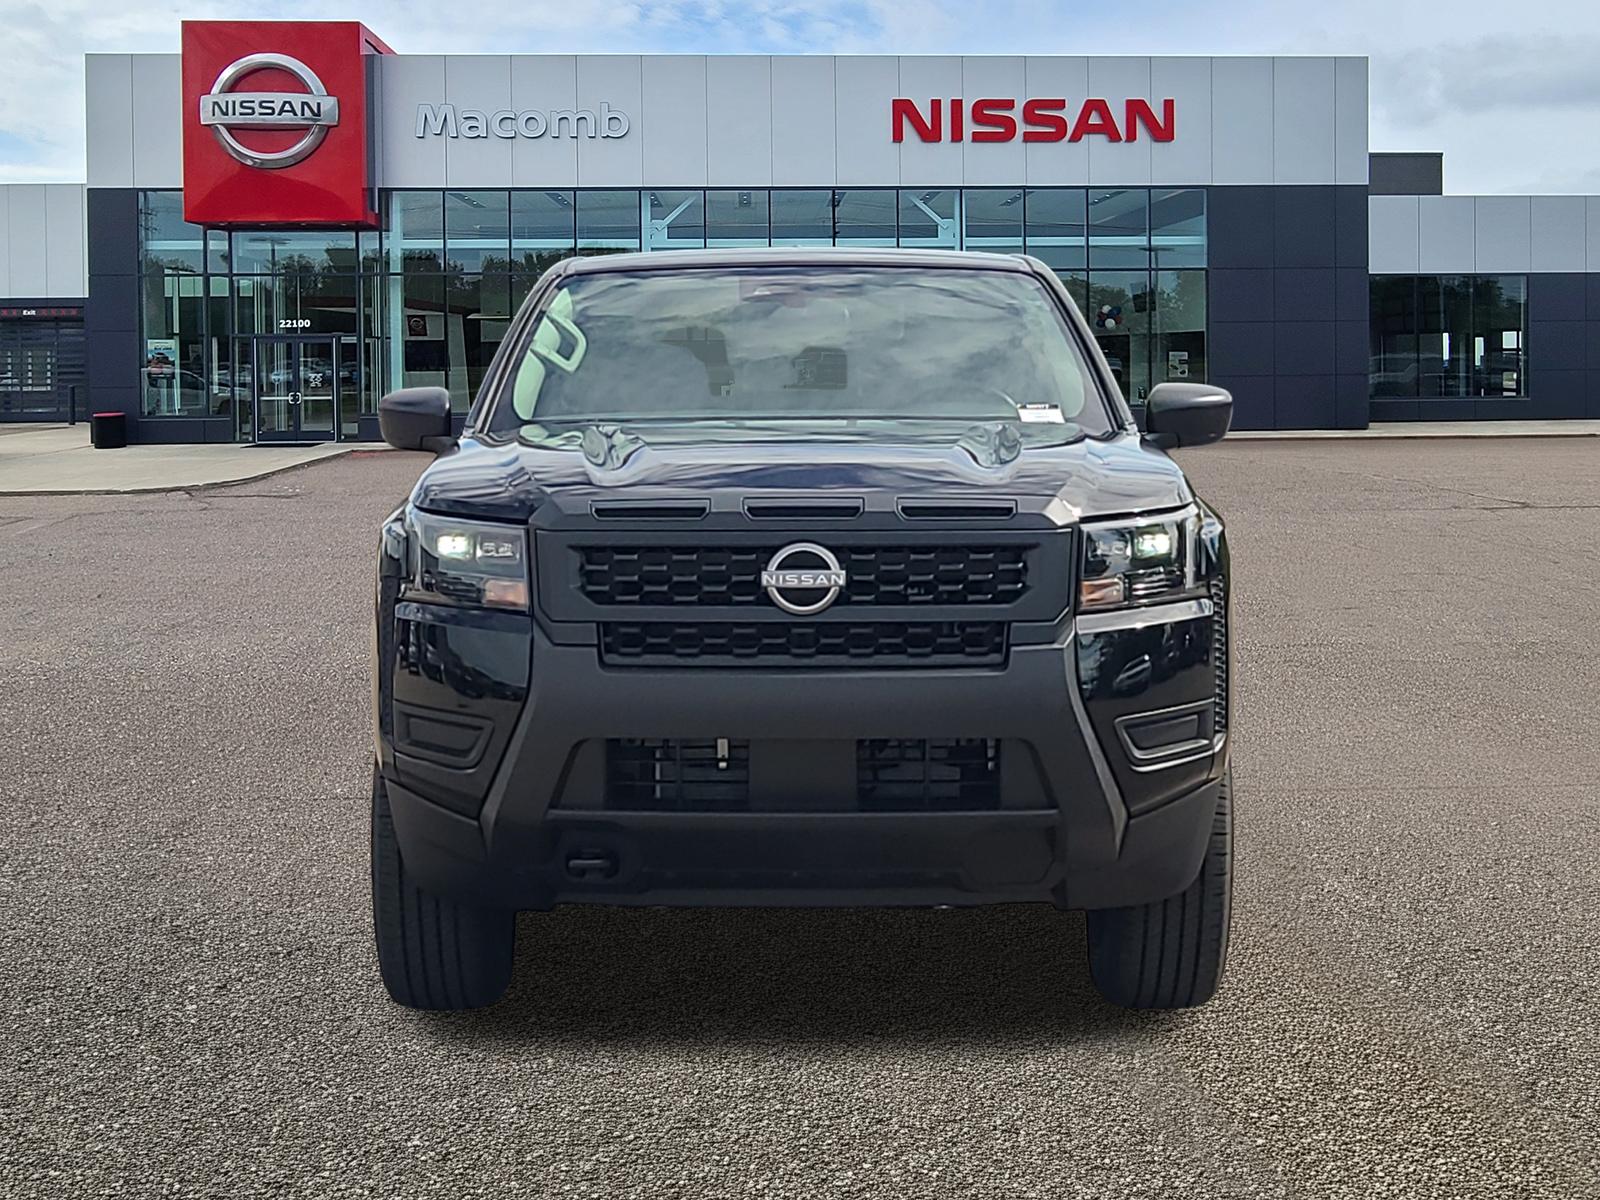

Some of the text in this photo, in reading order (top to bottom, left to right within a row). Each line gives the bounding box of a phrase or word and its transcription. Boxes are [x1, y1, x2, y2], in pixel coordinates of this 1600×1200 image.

[211, 100, 321, 117] NISSAN
[415, 102, 630, 139] Macomb
[892, 98, 1175, 143] NISSAN
[279, 319, 311, 328] 22100
[763, 574, 844, 585] NISSAN
